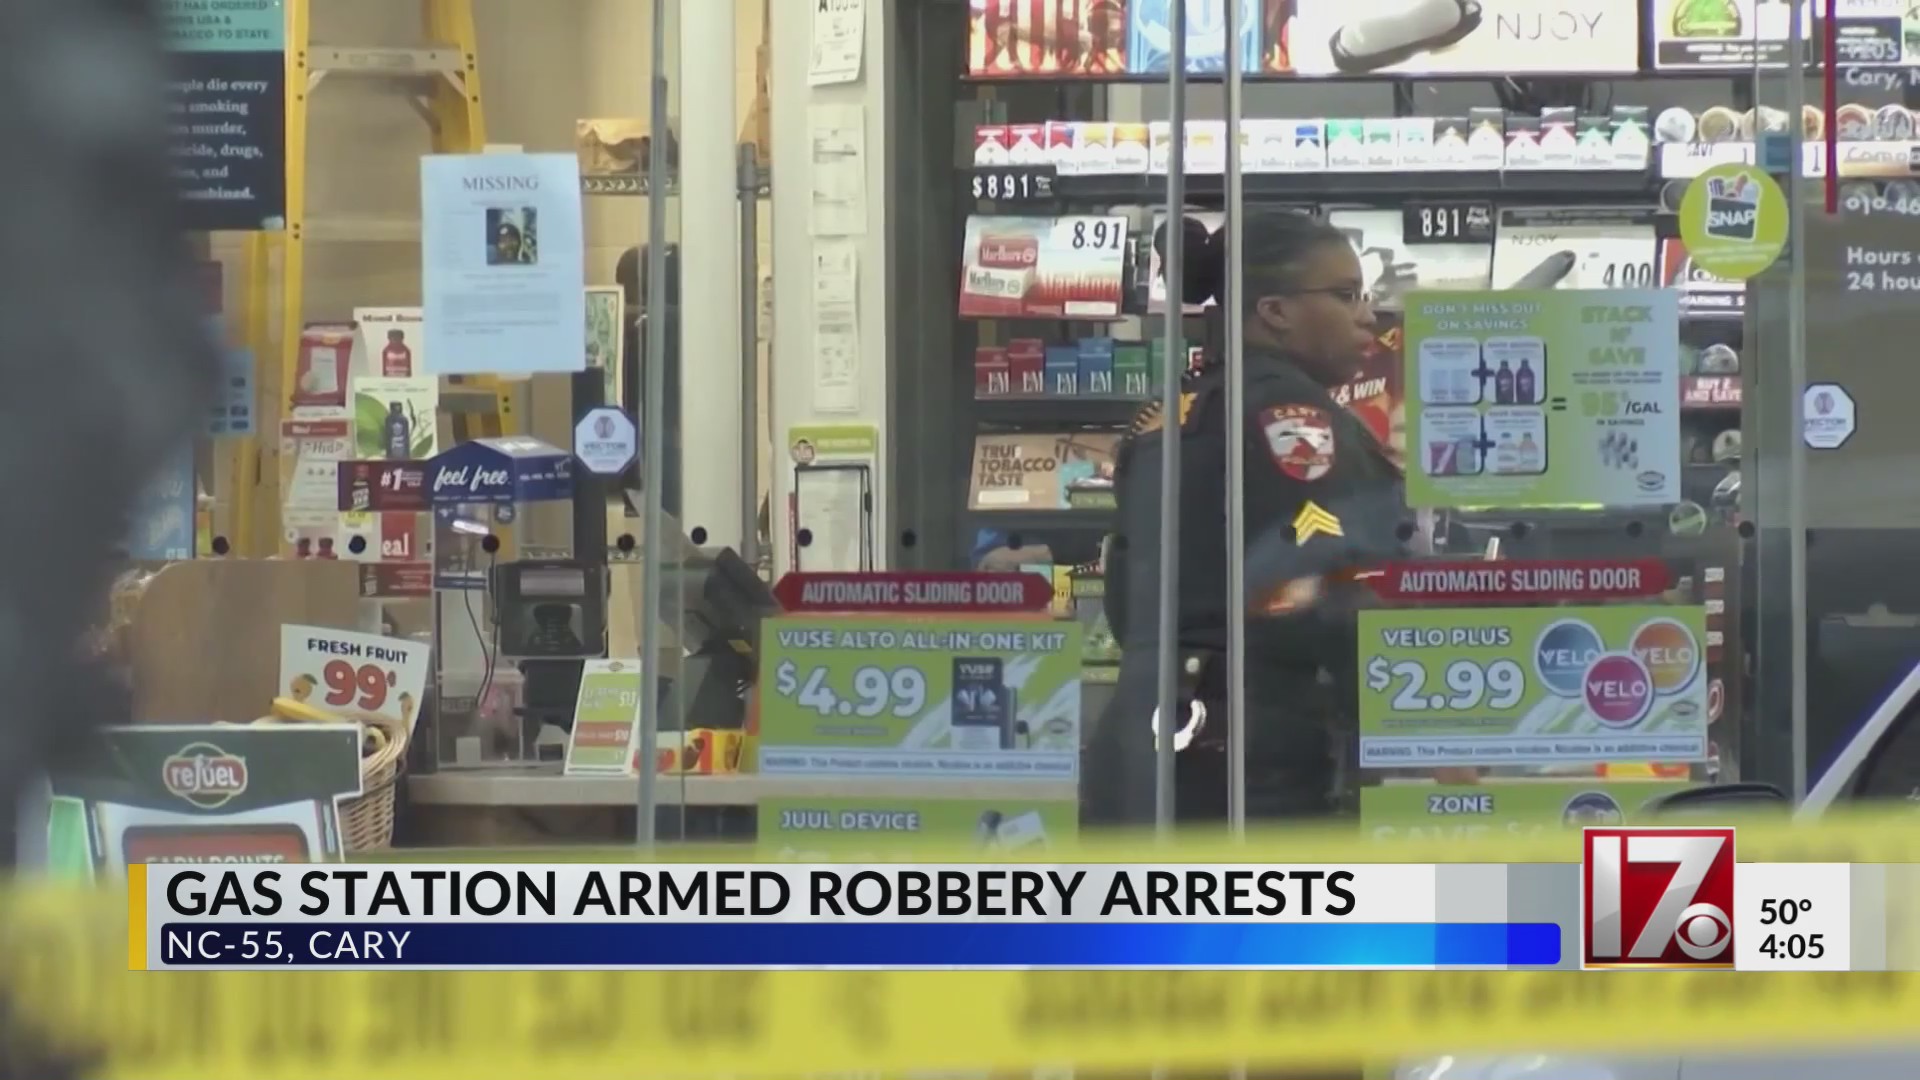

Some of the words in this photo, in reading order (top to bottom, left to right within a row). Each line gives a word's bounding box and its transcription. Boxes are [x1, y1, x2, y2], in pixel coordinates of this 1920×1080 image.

[1497, 11, 1603, 40] NJOY
[206, 78, 228, 91] die
[230, 80, 269, 93] every
[1846, 67, 1902, 90] Cary,
[189, 99, 249, 115] smoking
[220, 144, 264, 159] drugs,
[202, 165, 229, 178] and
[463, 175, 539, 191] MISSING
[1708, 209, 1756, 227] SNAP
[1072, 221, 1120, 250] 8.91
[1847, 246, 1911, 265] Hours
[1847, 271, 1875, 291] 24
[1464, 320, 1527, 330] SAVINGS
[1354, 378, 1386, 399] WIN
[981, 457, 1056, 472] TOBACCO
[380, 468, 402, 490] #1
[433, 466, 468, 492] feel
[469, 465, 508, 492] free
[979, 473, 1023, 486] TASTE
[1400, 570, 1506, 593] AUTOMATIC
[1511, 568, 1584, 592] SLIDING
[1589, 568, 1640, 590] DOOR
[802, 581, 899, 604] AUTOMATIC
[904, 582, 971, 604] SLIDING
[976, 582, 1024, 605] DOOR
[778, 630, 833, 648] VUSE
[840, 631, 895, 649] ALTO
[902, 632, 1024, 650] ALL-IN-ONE
[1031, 632, 1066, 650] KIT
[1383, 628, 1445, 647] VELO
[1452, 627, 1511, 646] PLUS
[307, 638, 361, 657] FRESH
[366, 646, 408, 664] FRUIT
[1540, 649, 1598, 666] VELO
[1634, 648, 1692, 665] VELO
[776, 659, 927, 717] $4.99
[1367, 656, 1525, 711] $2.99
[1589, 680, 1647, 698] VELO
[1428, 795, 1494, 813] ZONE
[780, 810, 833, 829] JUUL
[840, 810, 920, 830] DEVICE
